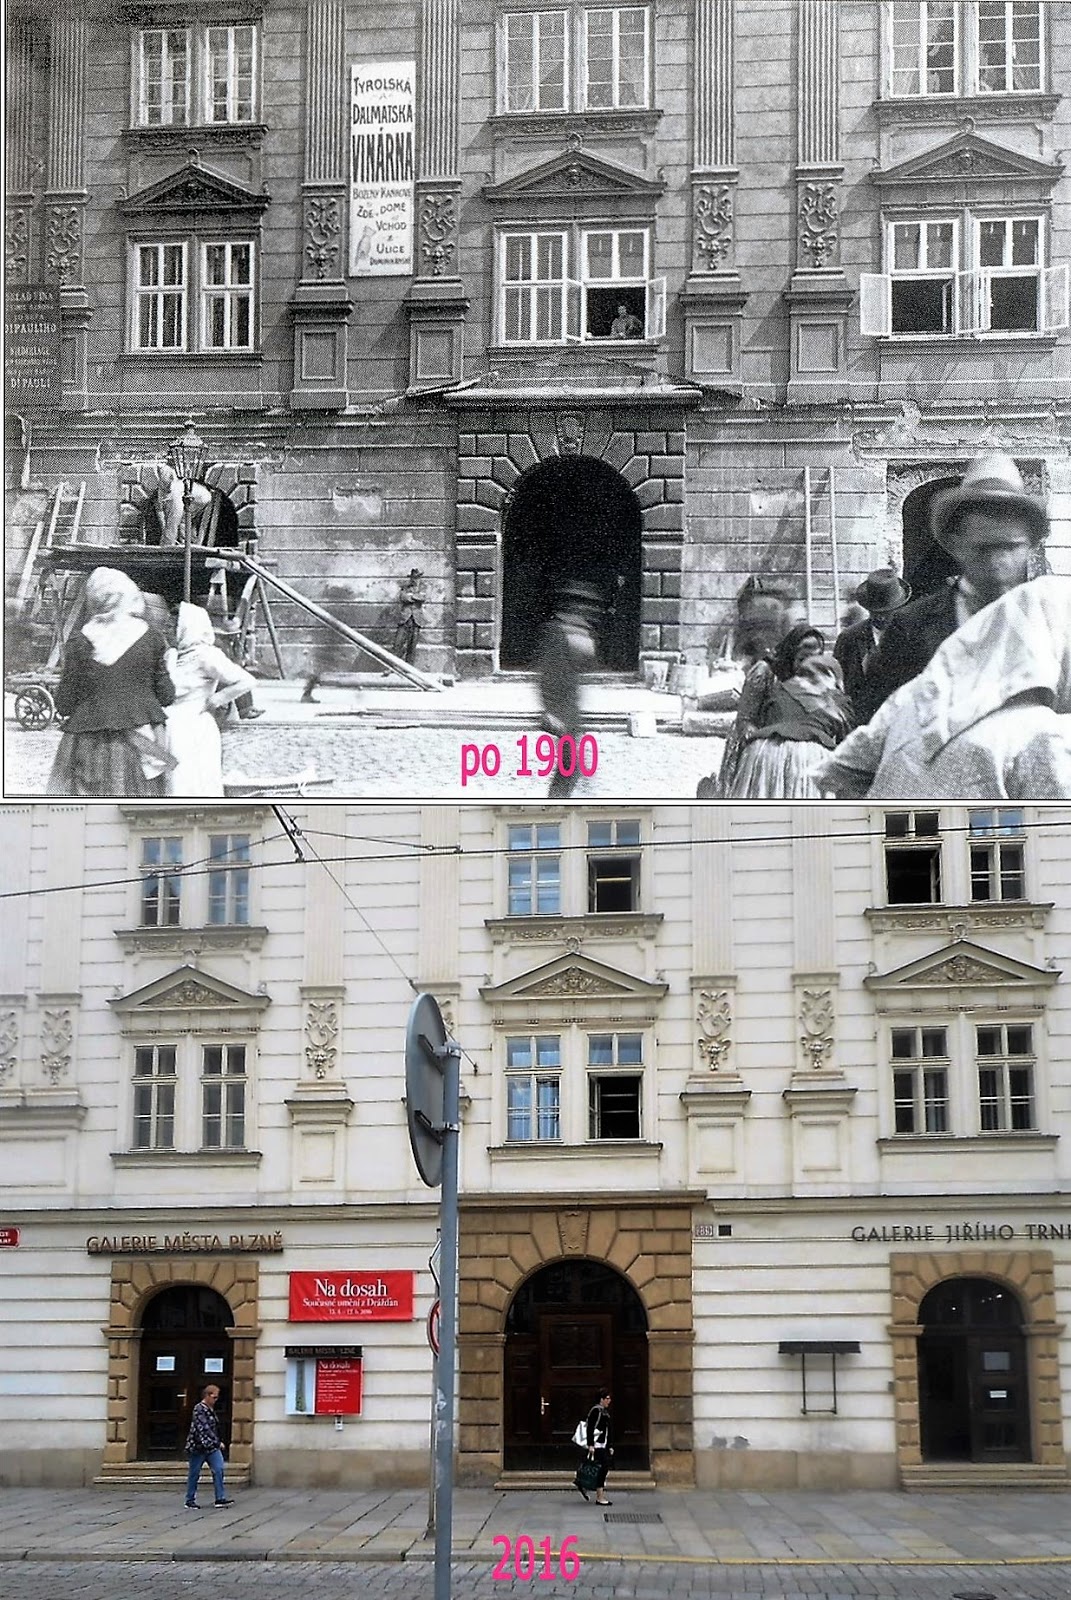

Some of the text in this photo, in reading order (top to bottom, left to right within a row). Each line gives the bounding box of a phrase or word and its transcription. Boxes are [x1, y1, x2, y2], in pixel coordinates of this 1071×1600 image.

[352, 126, 414, 183] VINÁRNA
[375, 220, 407, 231] VCHOD
[376, 243, 405, 254] ULICE
[87, 1230, 283, 1254] GALERIE MĚSTA PLZNĚ
[851, 1226, 935, 1242] GALERIE
[946, 1221, 1014, 1243] JIŘÍHO
[314, 1278, 388, 1297] Na dosah
